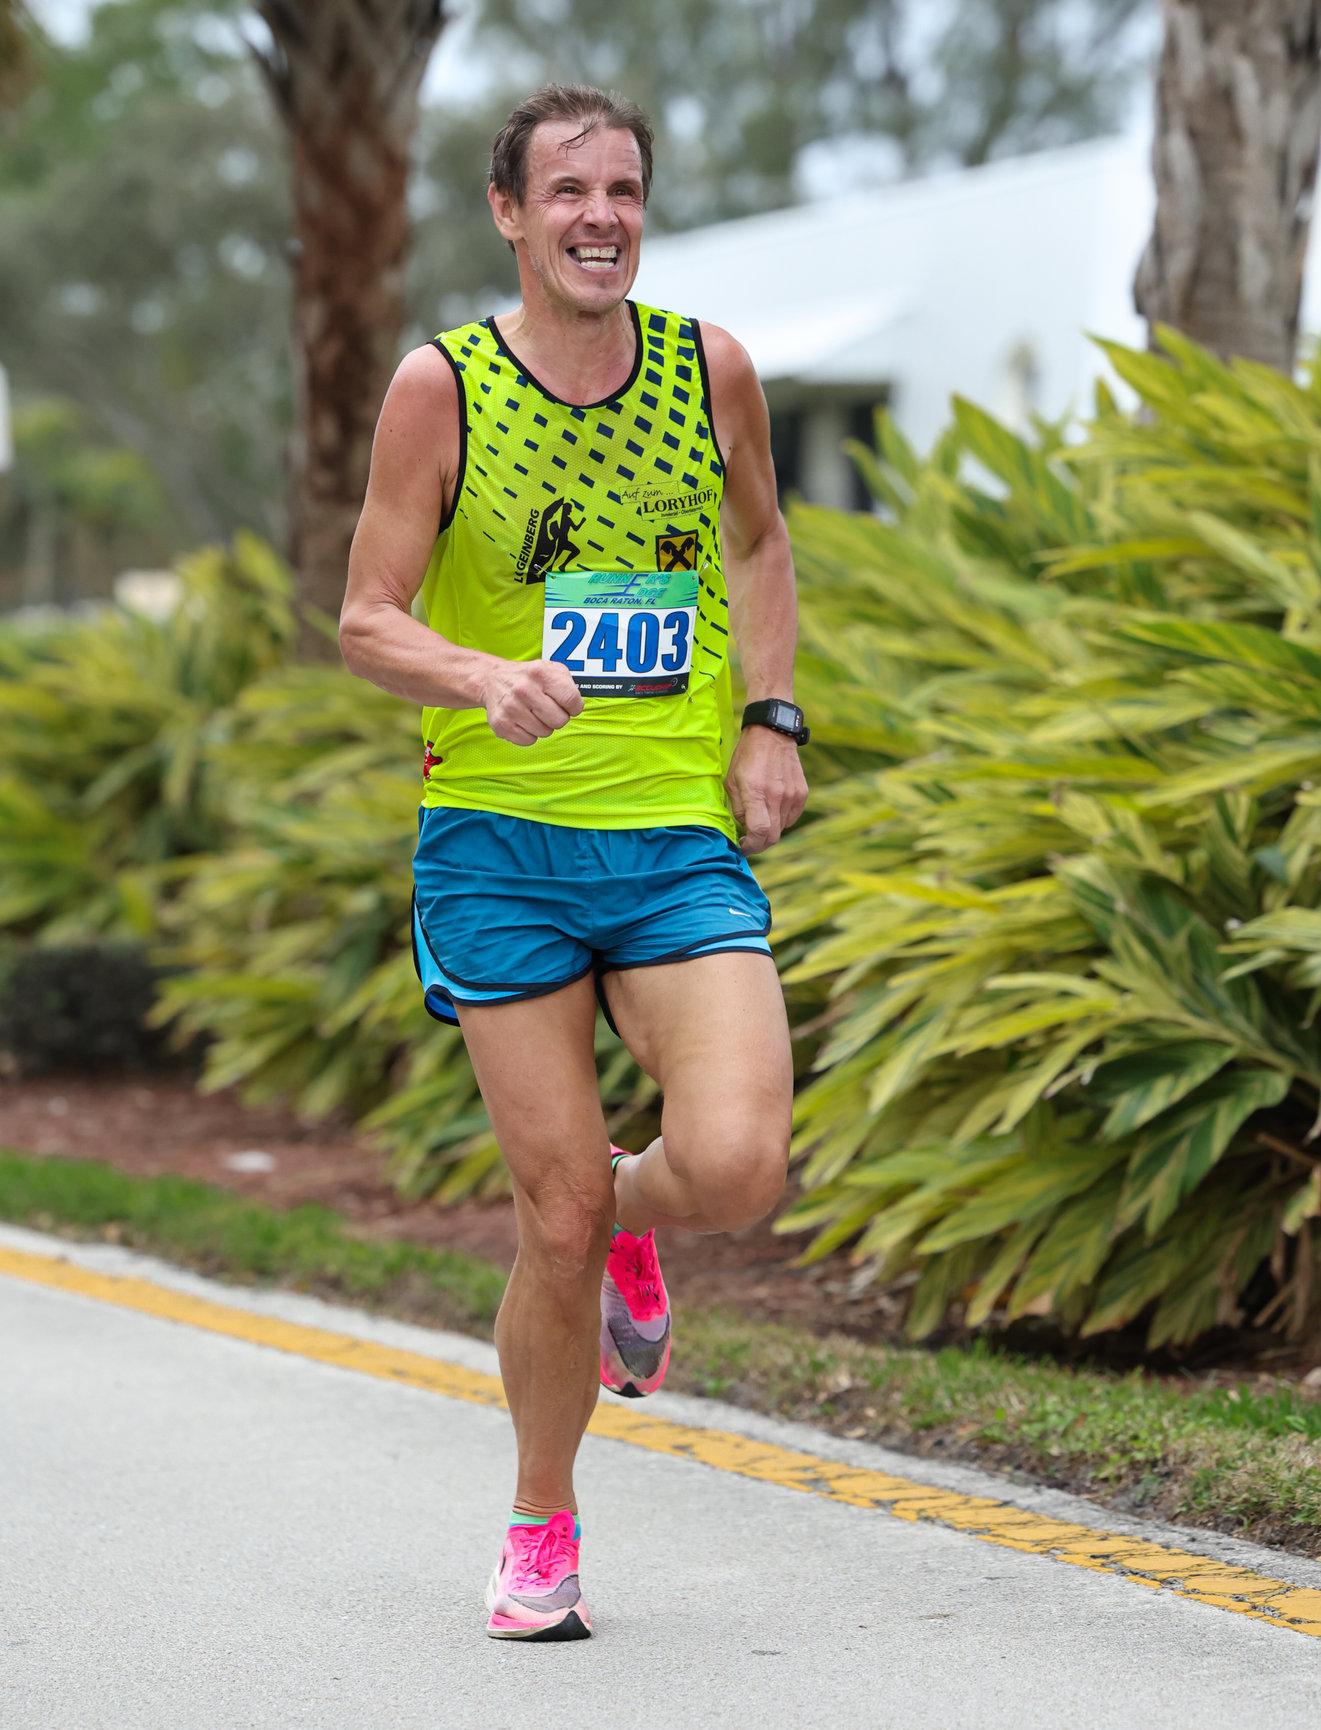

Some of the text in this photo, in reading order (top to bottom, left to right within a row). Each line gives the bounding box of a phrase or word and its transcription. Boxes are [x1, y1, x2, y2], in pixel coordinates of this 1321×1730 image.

[622, 487, 640, 500] Auf
[642, 489, 663, 498] zum
[643, 488, 713, 513] LORYHOF
[610, 597, 642, 605] RATON,
[550, 611, 690, 673] 2403
